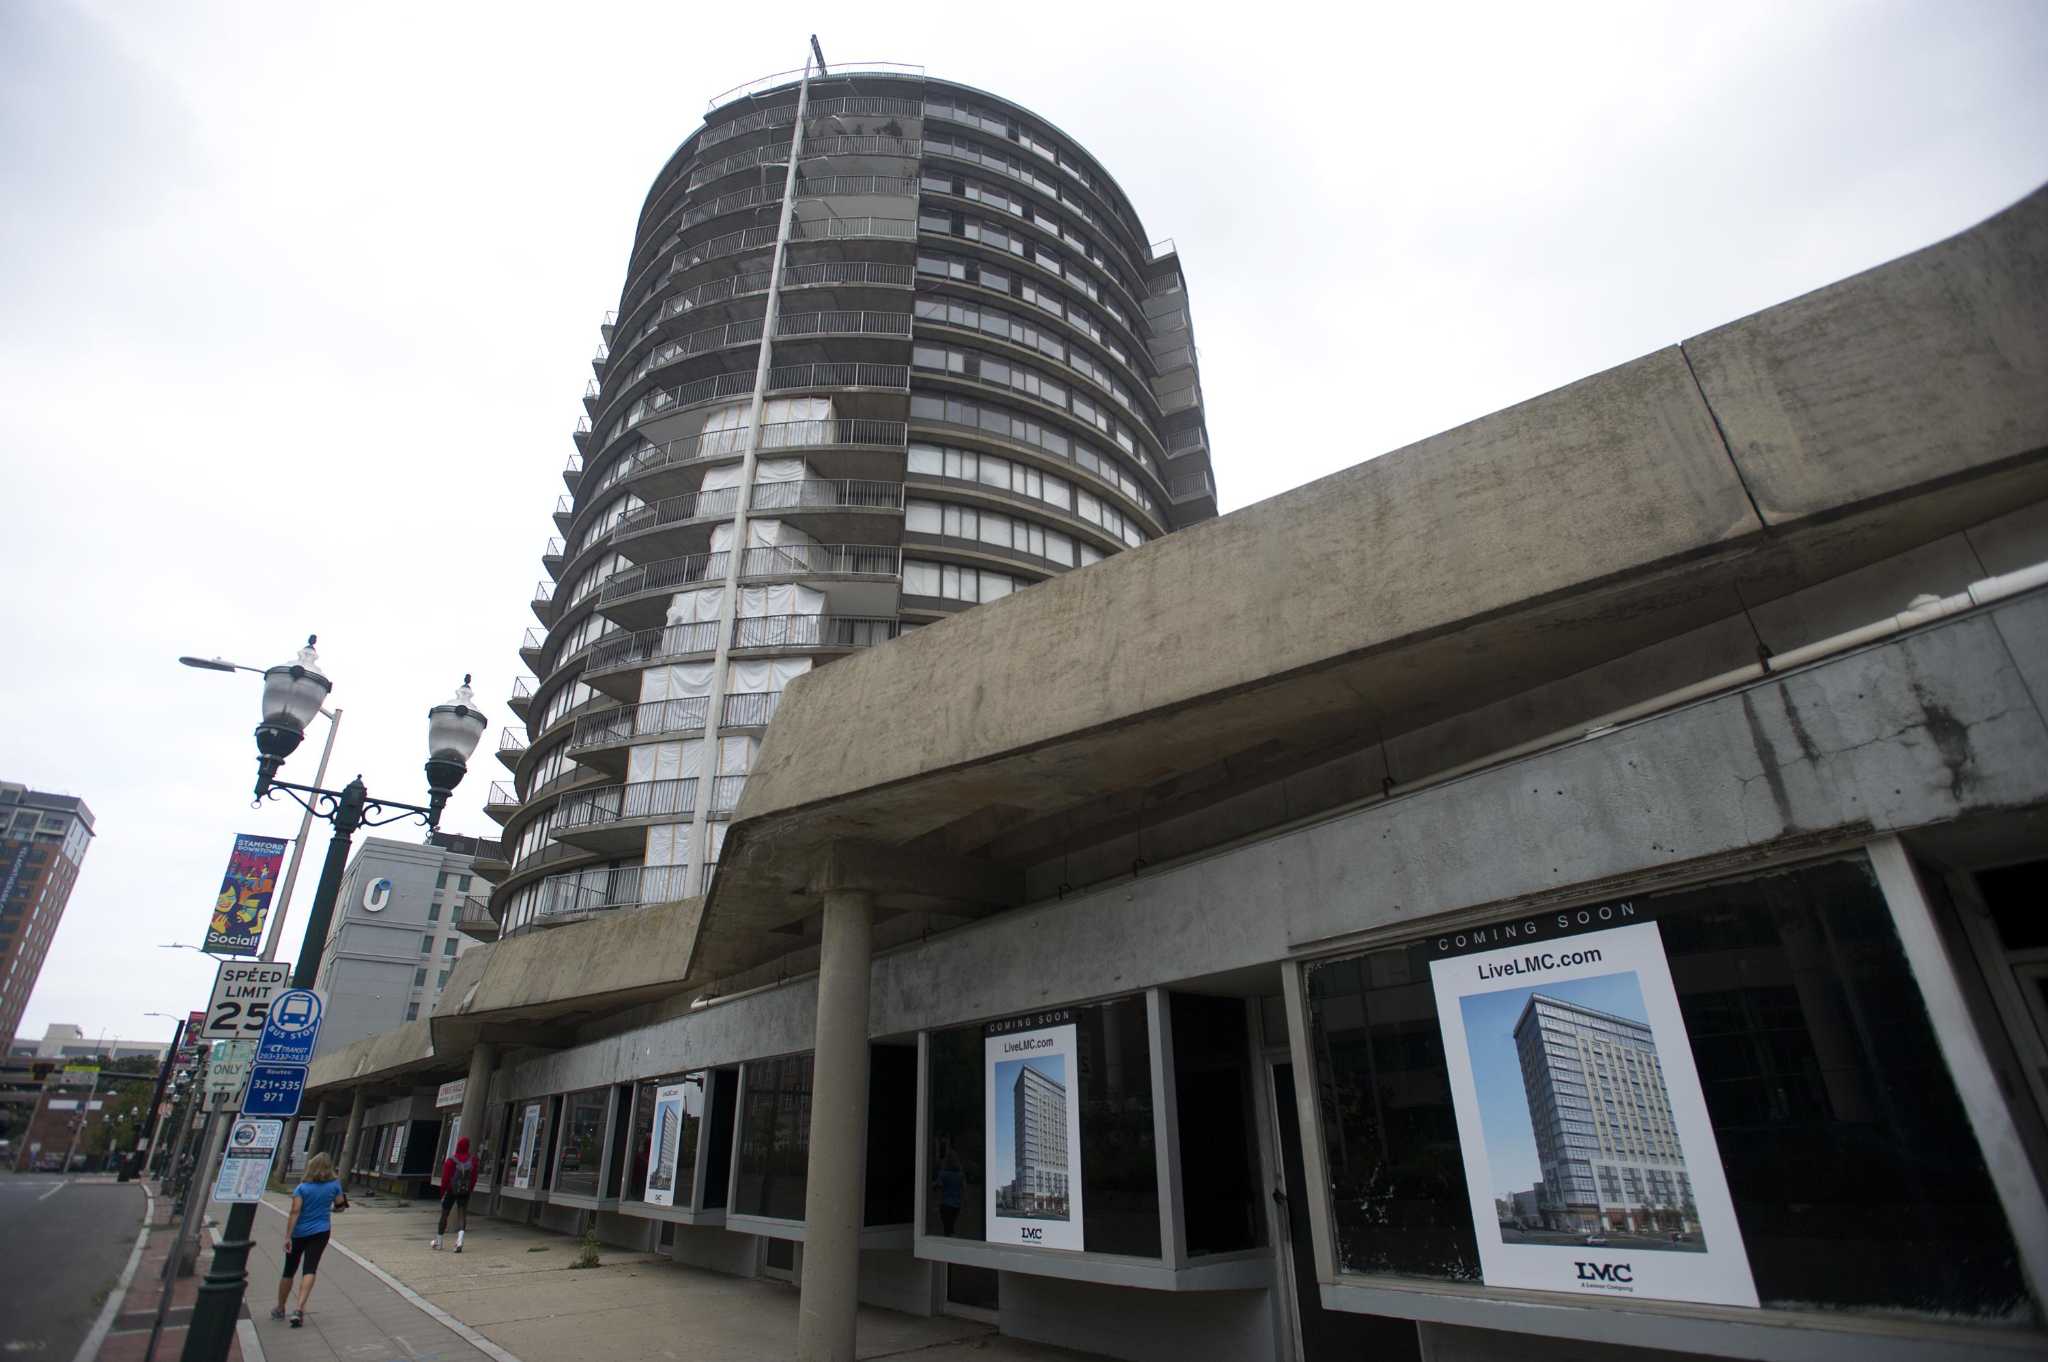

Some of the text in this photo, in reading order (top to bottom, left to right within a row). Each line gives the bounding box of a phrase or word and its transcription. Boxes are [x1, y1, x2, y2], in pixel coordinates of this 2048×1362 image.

[238, 840, 284, 850] STAMFORD
[1438, 902, 1635, 950] COMING SOON
[208, 932, 258, 947] Social!
[1478, 949, 1602, 980] LiveLMC.com
[223, 970, 282, 982] SPEED
[225, 986, 271, 998] LIMIT
[210, 1002, 269, 1030] 25
[990, 1011, 1069, 1032] COMING SOON
[268, 1025, 315, 1039] BUS STOP
[1004, 1038, 1054, 1053] LiveLMC.com
[214, 1064, 243, 1075] ONLY
[263, 1092, 284, 1102] 971
[1021, 1227, 1042, 1239] LMC
[1574, 1261, 1633, 1283] LMC
